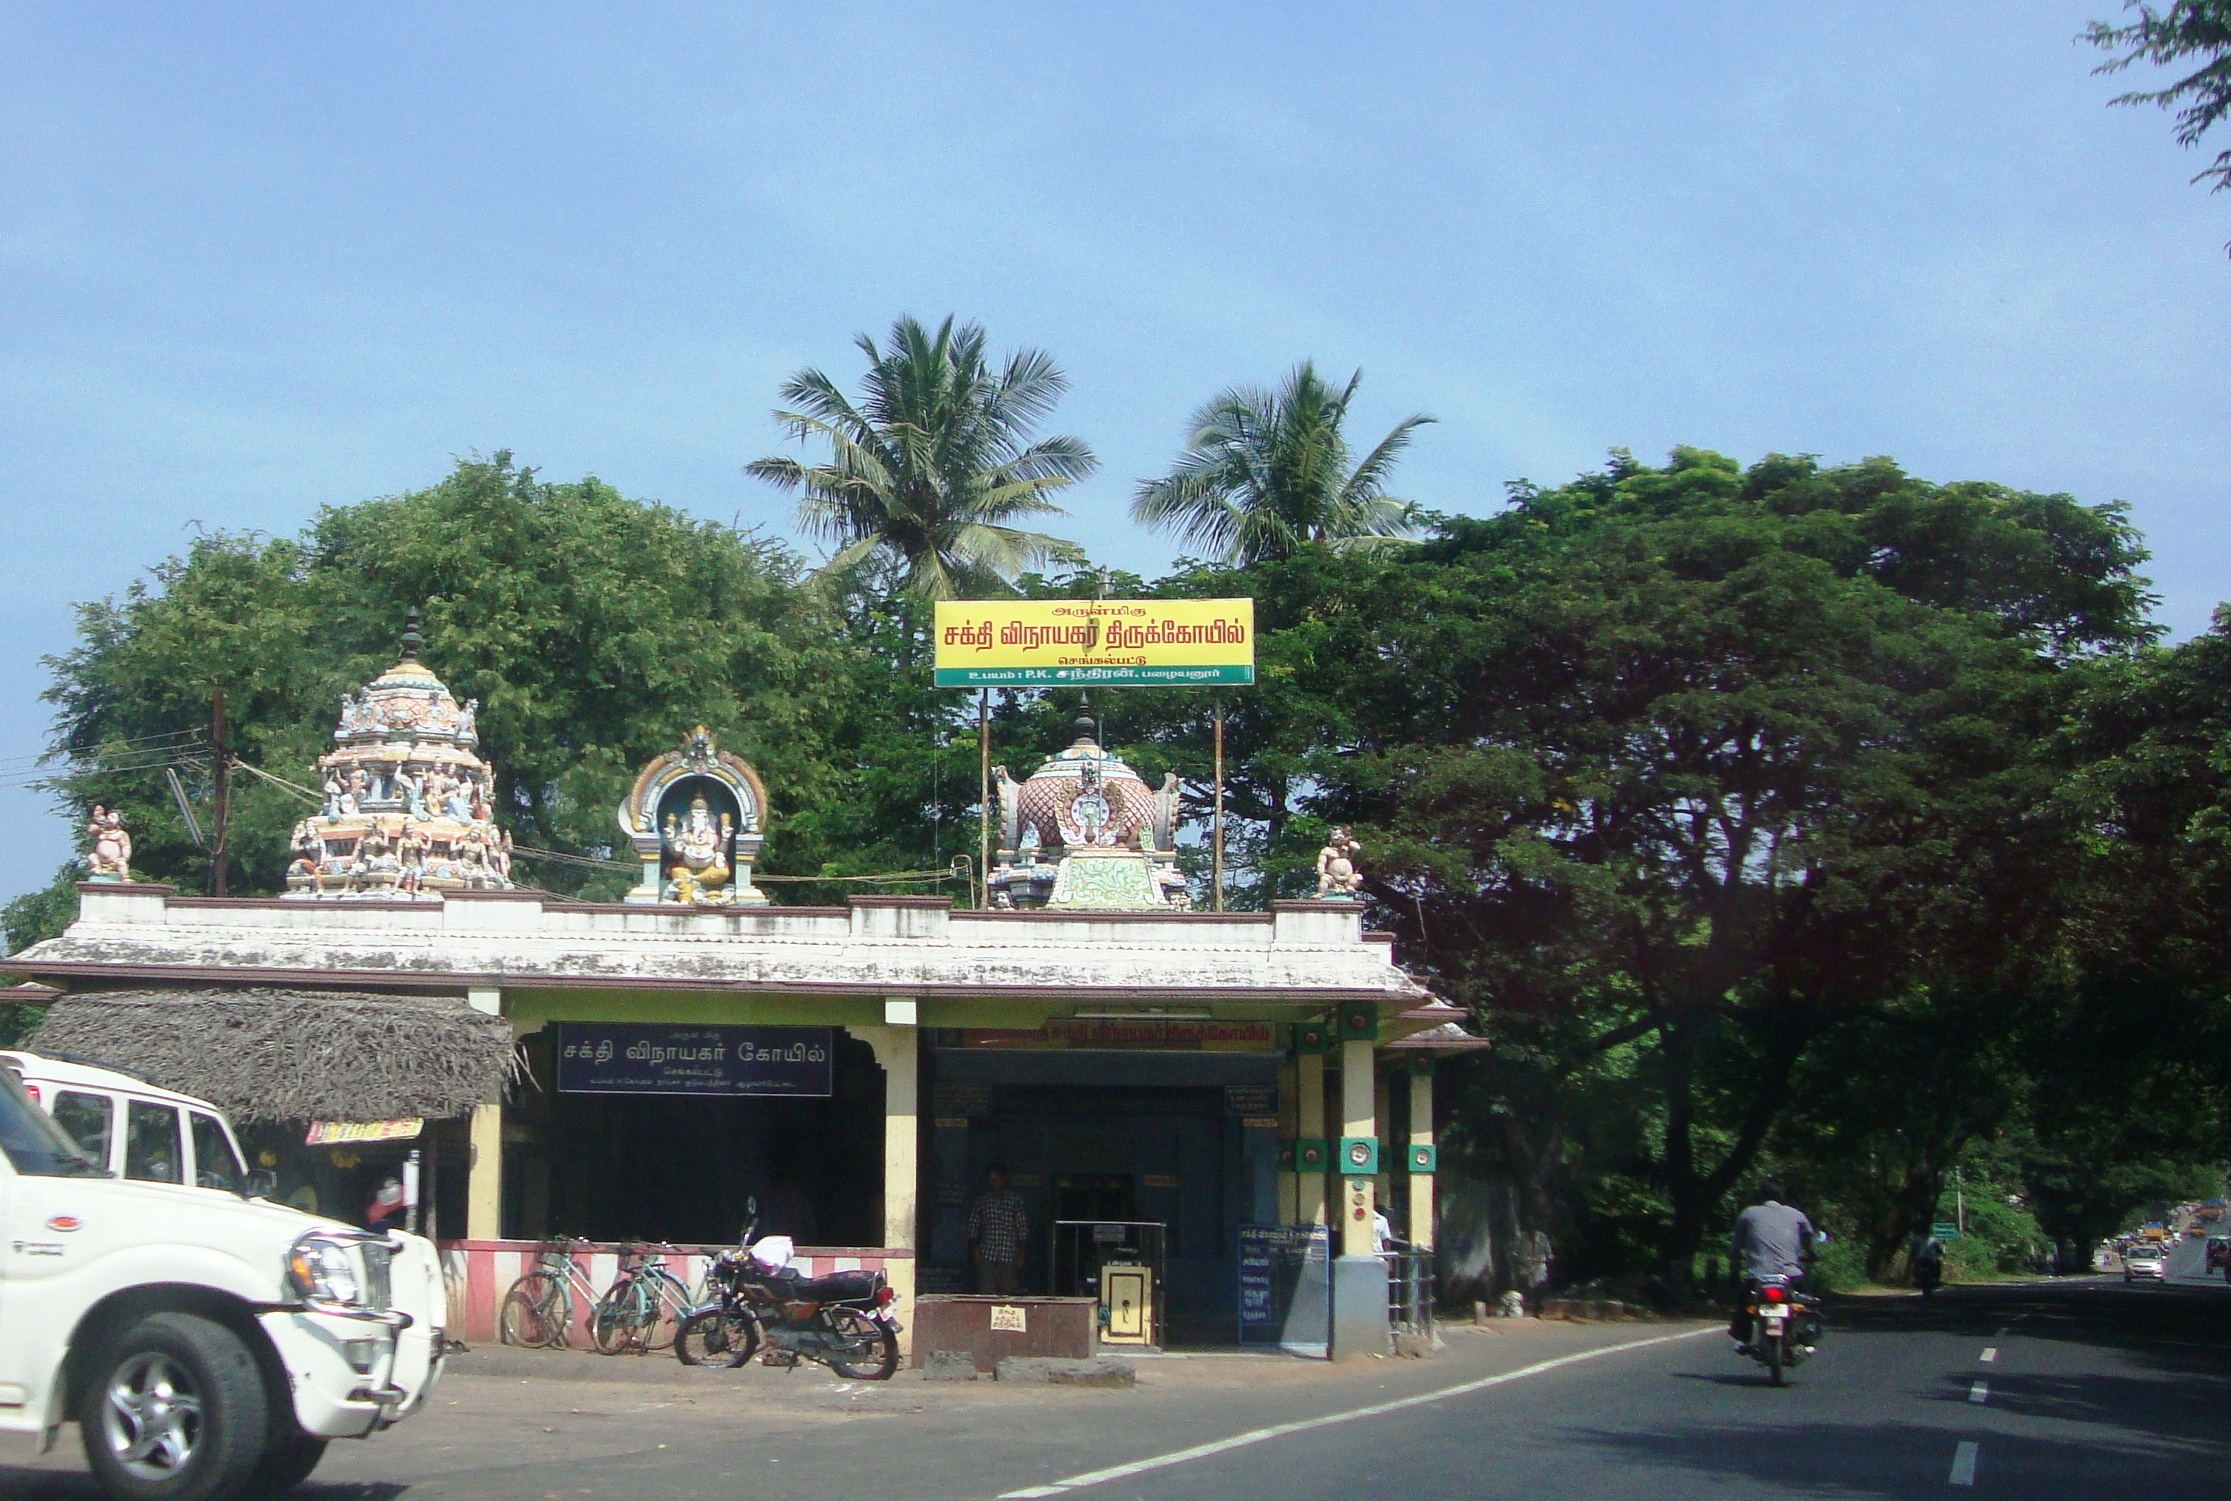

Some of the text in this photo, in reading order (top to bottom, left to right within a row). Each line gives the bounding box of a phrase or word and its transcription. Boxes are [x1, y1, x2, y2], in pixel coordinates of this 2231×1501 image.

[1051, 605, 1147, 618] அருள்மிகு
[944, 617, 1246, 653] சக்தி விநாயகர் திருக்கோயில்
[1058, 653, 1147, 667] செங்கல்பட்டு
[1024, 668, 1052, 679] P.K.
[563, 1039, 826, 1067] சக்தி விநாயகர் கோயில்
